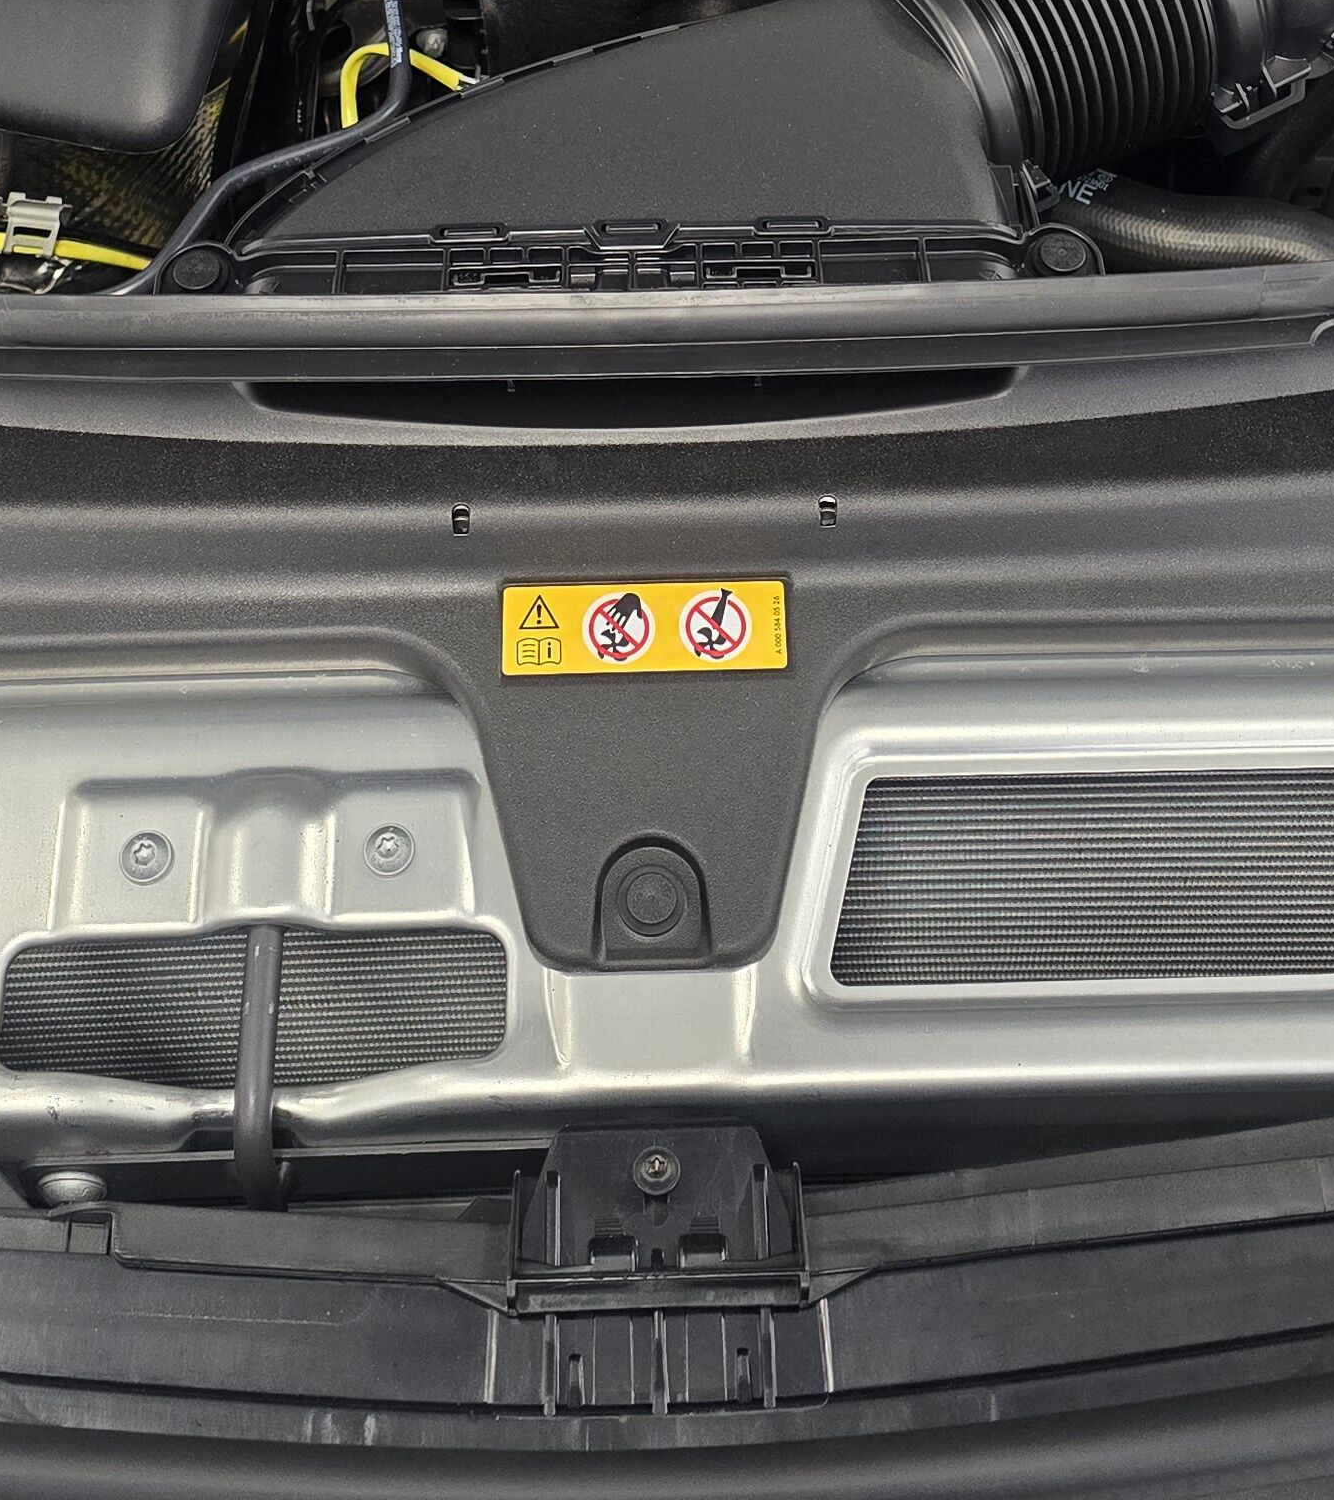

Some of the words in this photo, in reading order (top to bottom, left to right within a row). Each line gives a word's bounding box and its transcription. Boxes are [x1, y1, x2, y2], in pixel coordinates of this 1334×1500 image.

[772, 596, 780, 605] 26
[773, 606, 781, 616] 05
[773, 617, 781, 631] 584
[774, 633, 782, 648] 000
